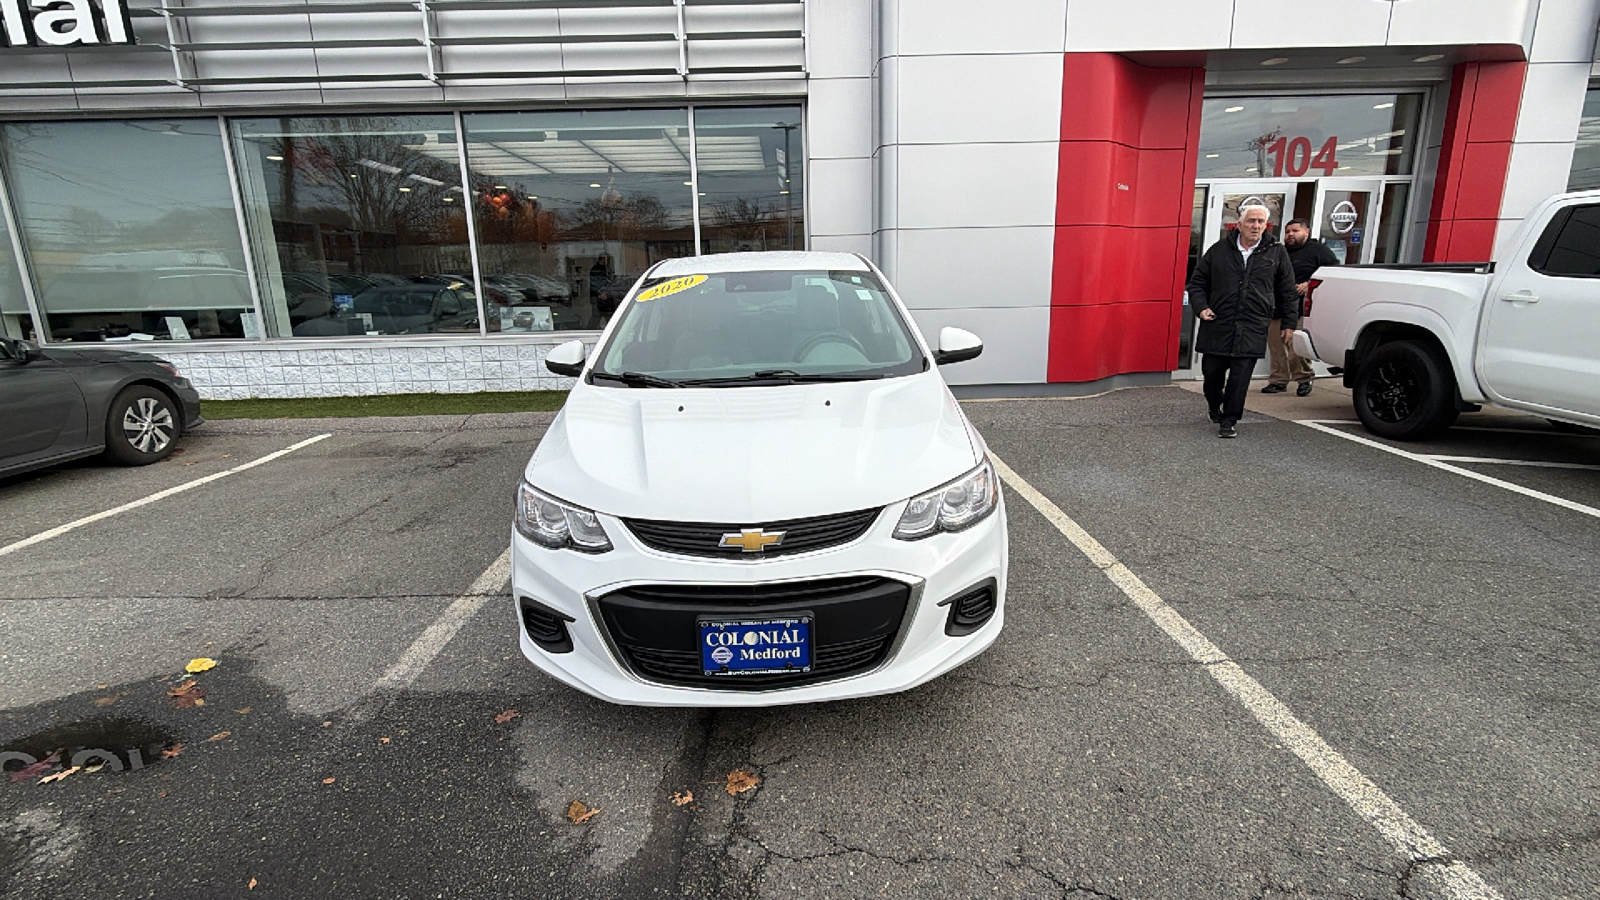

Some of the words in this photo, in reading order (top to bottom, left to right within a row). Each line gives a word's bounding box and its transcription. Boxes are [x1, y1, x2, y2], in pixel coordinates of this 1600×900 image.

[1267, 136, 1338, 177] 104
[649, 277, 694, 298] 2020
[706, 629, 804, 646] COLONIAL
[740, 646, 801, 661] Medford
